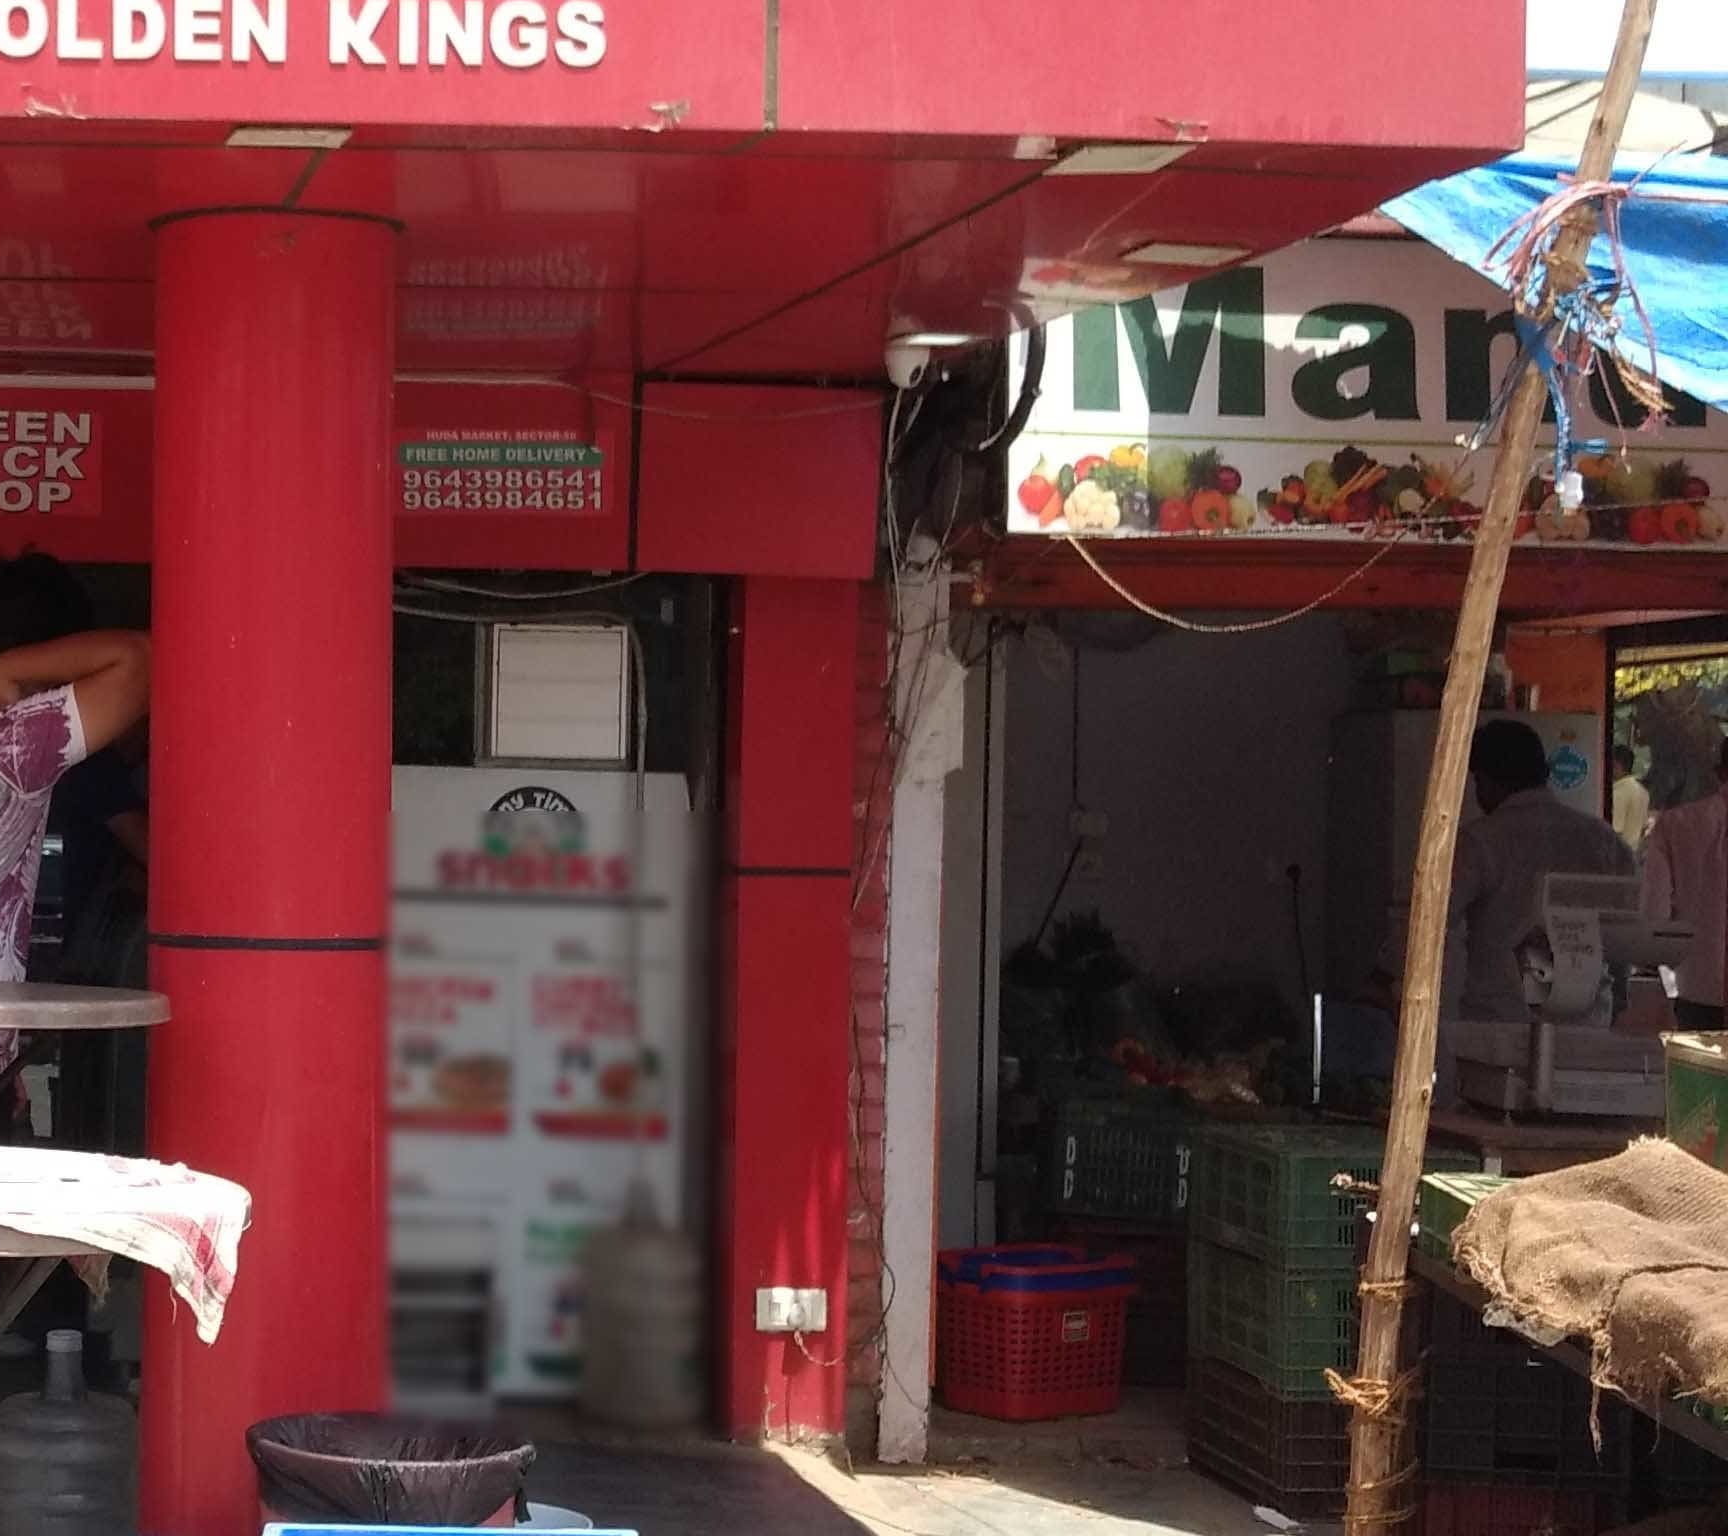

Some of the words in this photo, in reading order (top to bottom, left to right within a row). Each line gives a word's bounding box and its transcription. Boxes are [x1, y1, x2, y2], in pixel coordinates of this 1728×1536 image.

[1070, 267, 1709, 427] Man
[405, 447, 449, 462] FREE
[452, 447, 501, 462] HOME
[505, 448, 587, 463] DELIVERY
[402, 469, 602, 490] 9643986541
[402, 491, 602, 511] 9643984651
